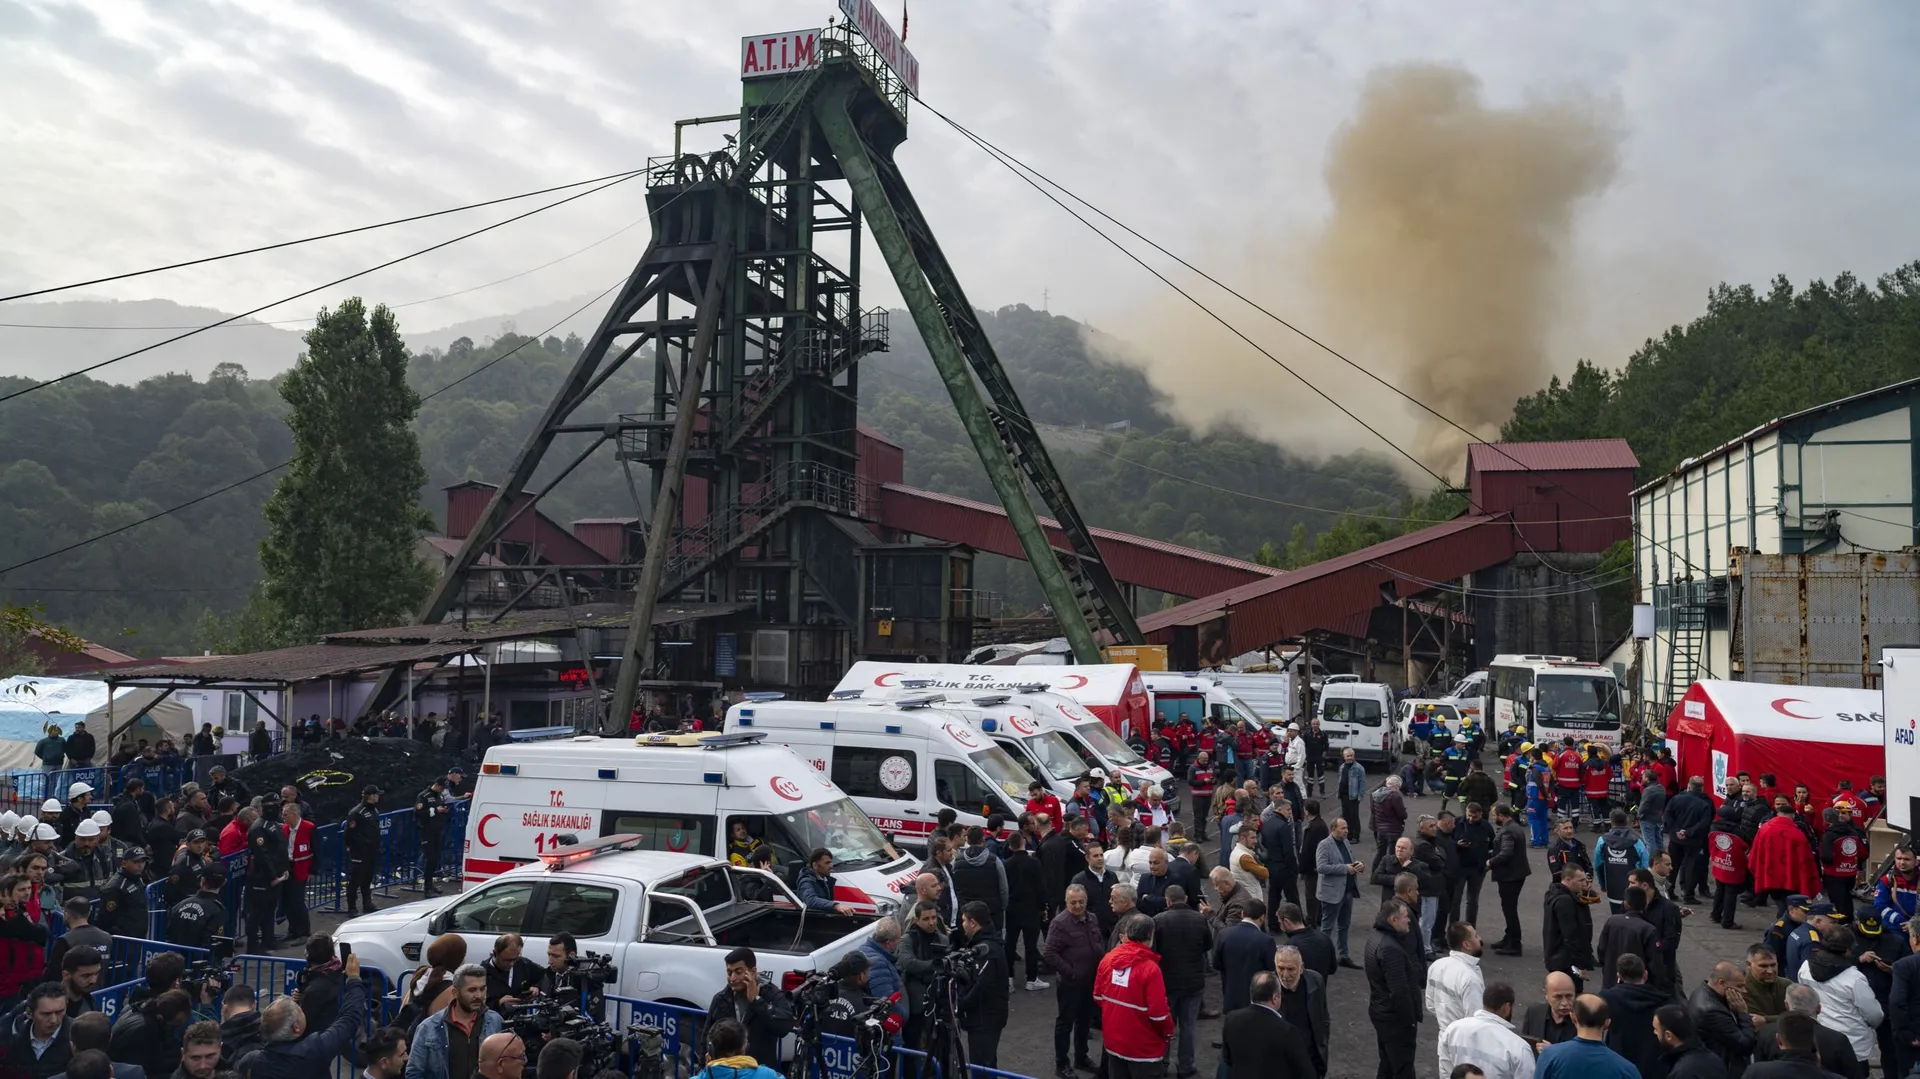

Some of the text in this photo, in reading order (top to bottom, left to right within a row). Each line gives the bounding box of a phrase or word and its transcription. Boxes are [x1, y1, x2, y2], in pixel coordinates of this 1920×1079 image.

[858, 0, 897, 69] AMASRA
[1563, 721, 1595, 729] ISUZU
[1894, 727, 1914, 745] AFAD
[778, 781, 800, 795] 112
[549, 790, 565, 808] T.C.
[522, 811, 592, 831] SAĞLIK BAKANLIĞI
[633, 1011, 676, 1036] POLİS
[822, 1046, 863, 1072] OLİS
